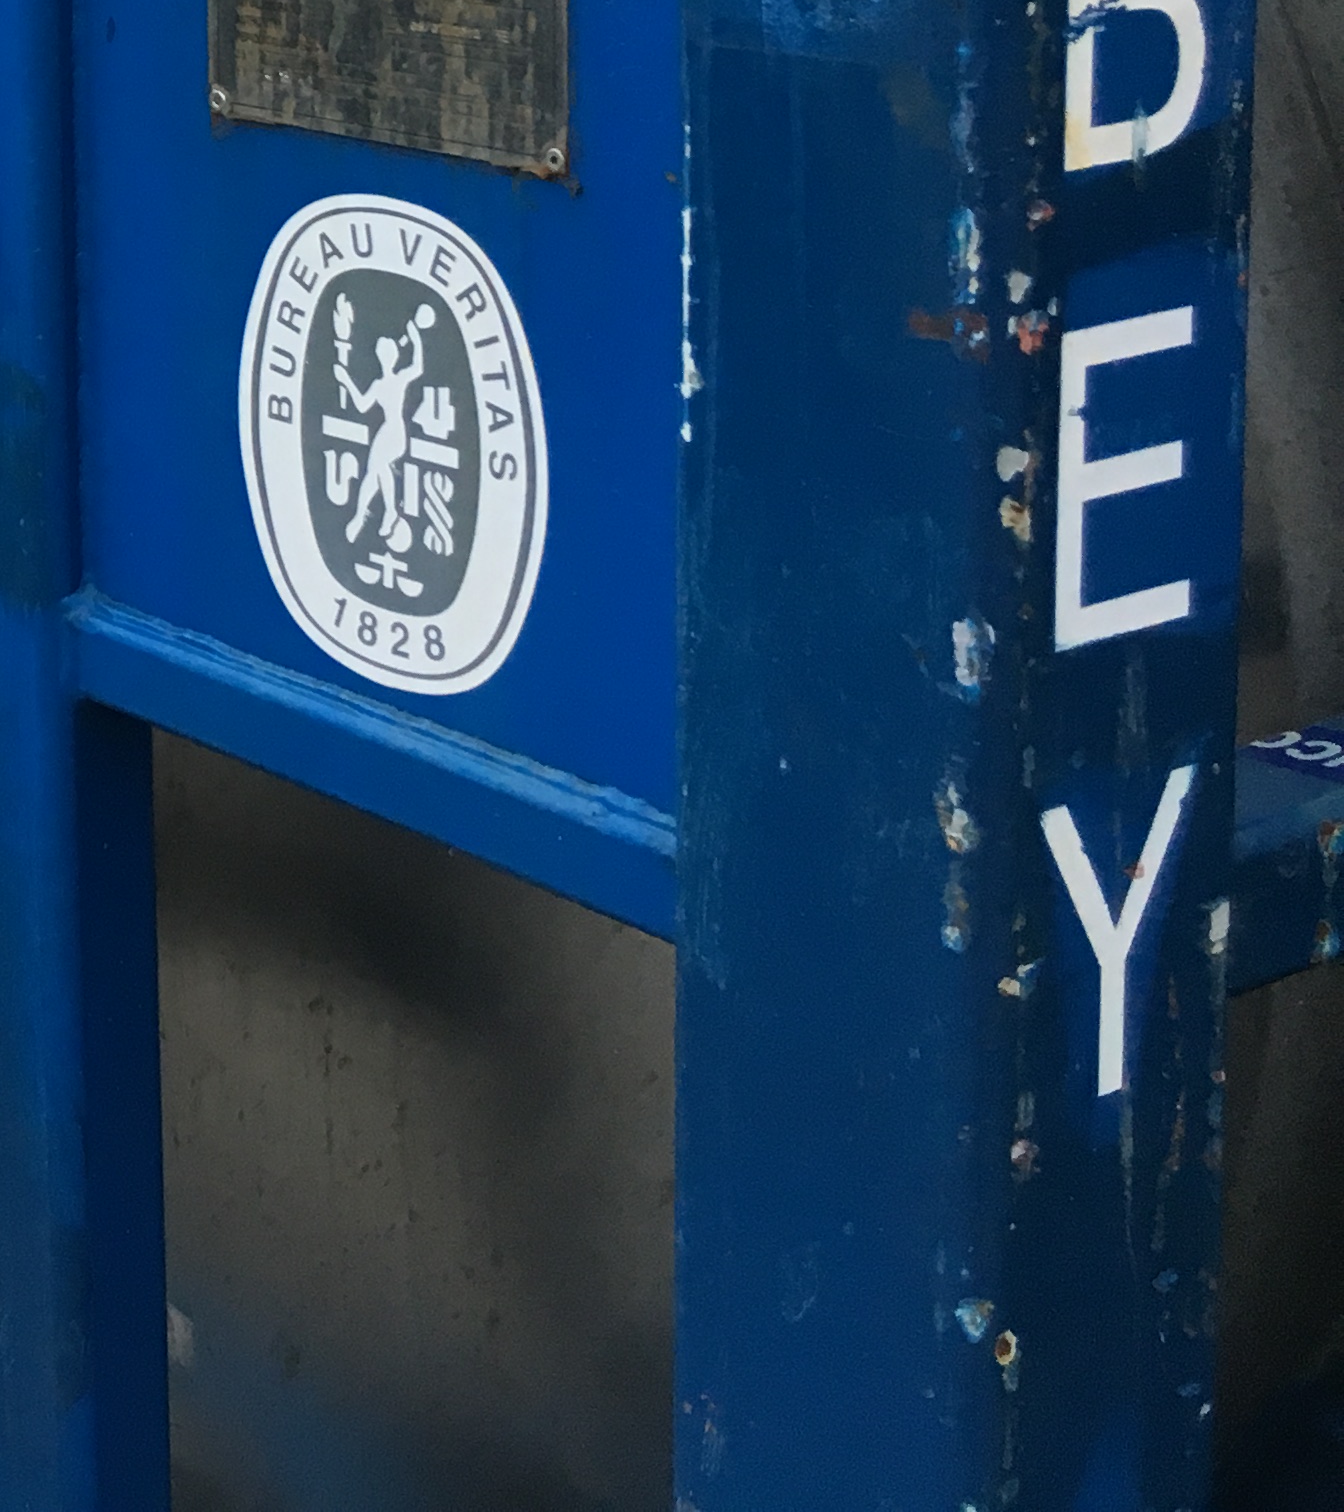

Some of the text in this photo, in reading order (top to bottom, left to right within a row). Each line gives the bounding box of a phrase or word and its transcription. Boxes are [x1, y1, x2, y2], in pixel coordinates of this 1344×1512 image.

[267, 222, 519, 481] BUREAU VERITAS
[333, 597, 447, 662] 1828
